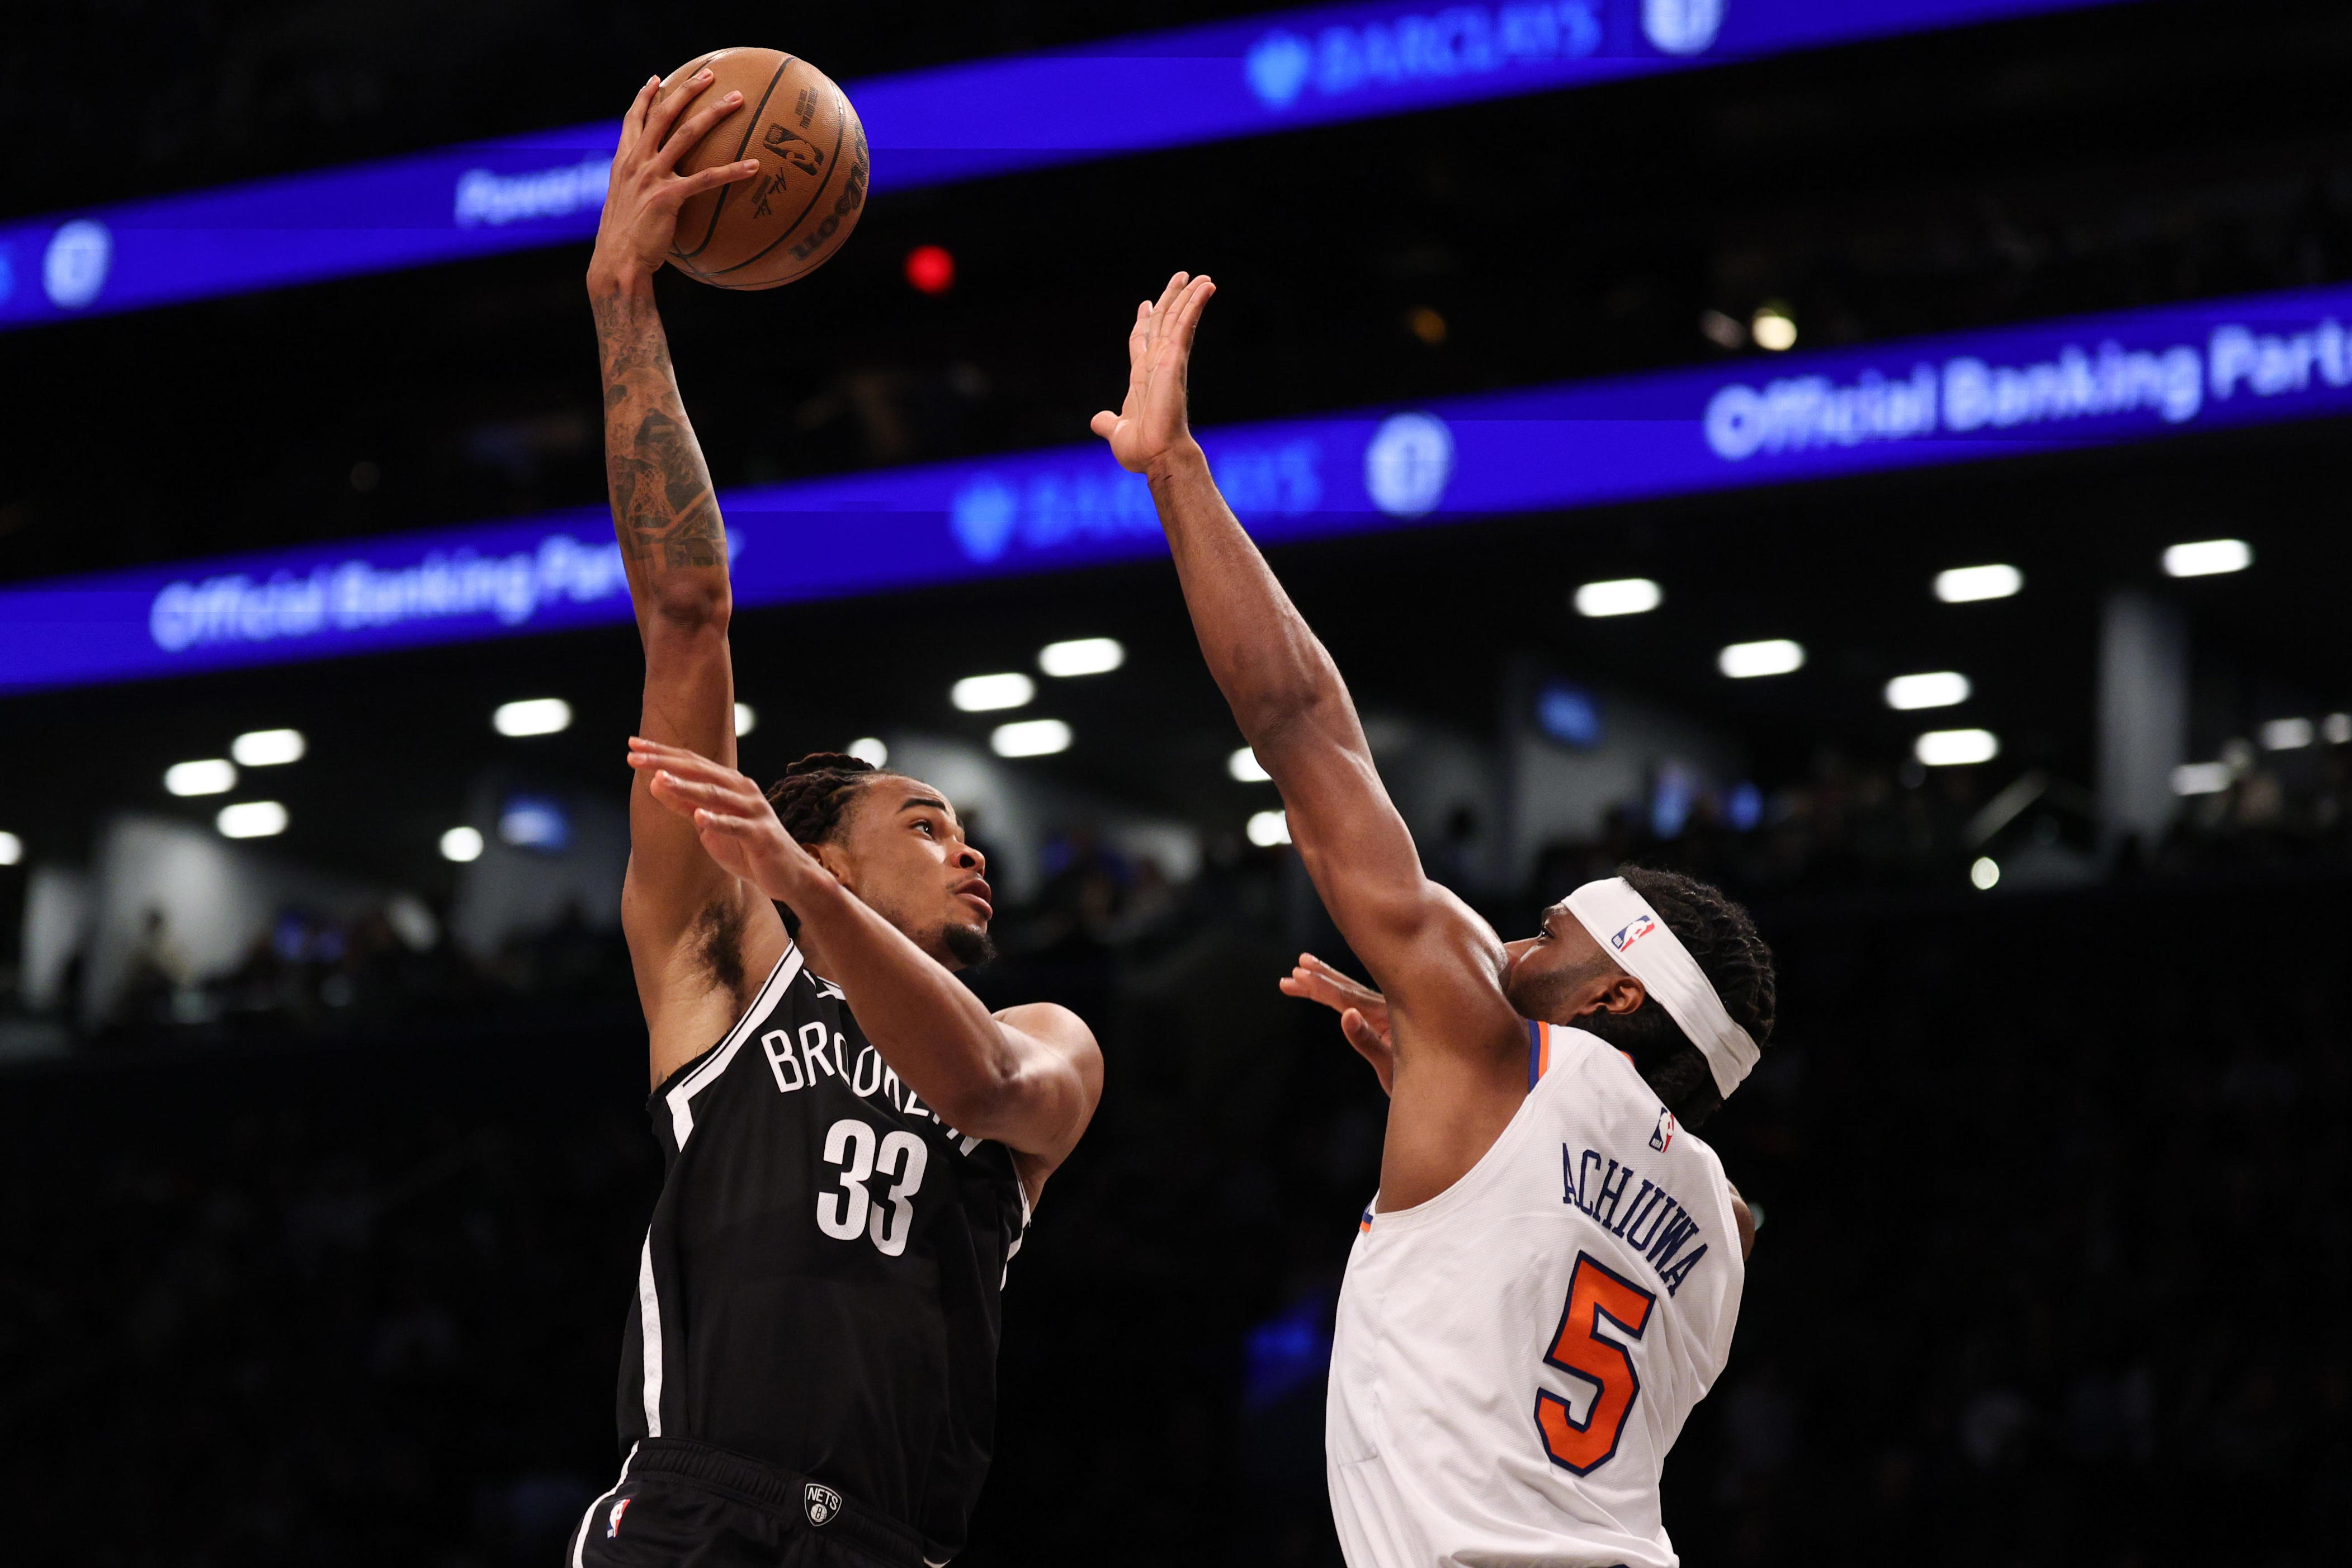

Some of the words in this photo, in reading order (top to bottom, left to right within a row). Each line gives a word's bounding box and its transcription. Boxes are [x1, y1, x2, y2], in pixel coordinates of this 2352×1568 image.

[455, 151, 611, 228] Powerin
[1706, 363, 1937, 461] Official
[1943, 343, 2200, 423] Banking
[2209, 317, 2352, 400] Part
[150, 570, 324, 653] Official
[337, 548, 535, 626] Banking
[816, 1119, 928, 1257] 33
[1650, 1137, 1663, 1150] NBA
[1562, 1142, 1708, 1298] ACHIUWA
[1533, 1249, 1656, 1477] 5
[807, 1486, 838, 1510] NETS
